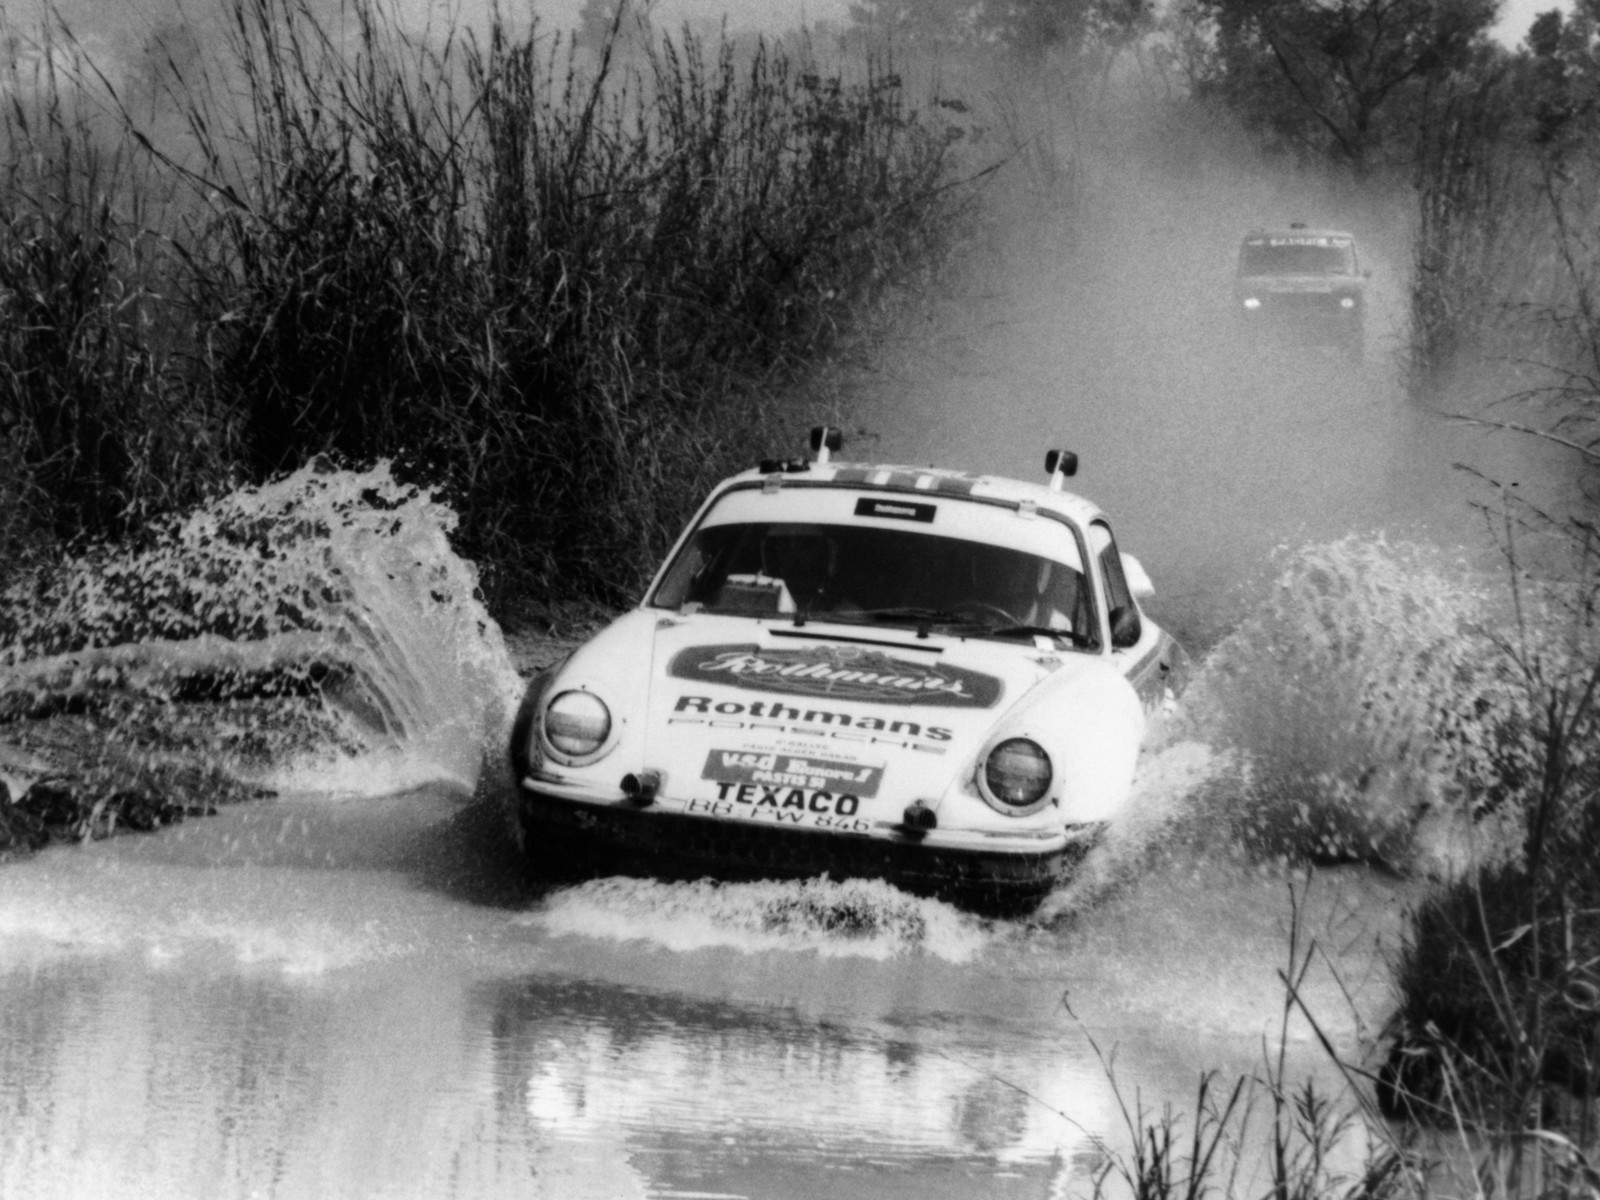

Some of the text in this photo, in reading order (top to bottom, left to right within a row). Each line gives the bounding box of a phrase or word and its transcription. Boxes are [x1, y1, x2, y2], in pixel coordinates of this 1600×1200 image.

[698, 652, 974, 698] Rothmans
[673, 695, 953, 741] Rothmans
[751, 770, 806, 787] PASTIS
[716, 782, 860, 816] TEXACO
[814, 814, 871, 833] 846
